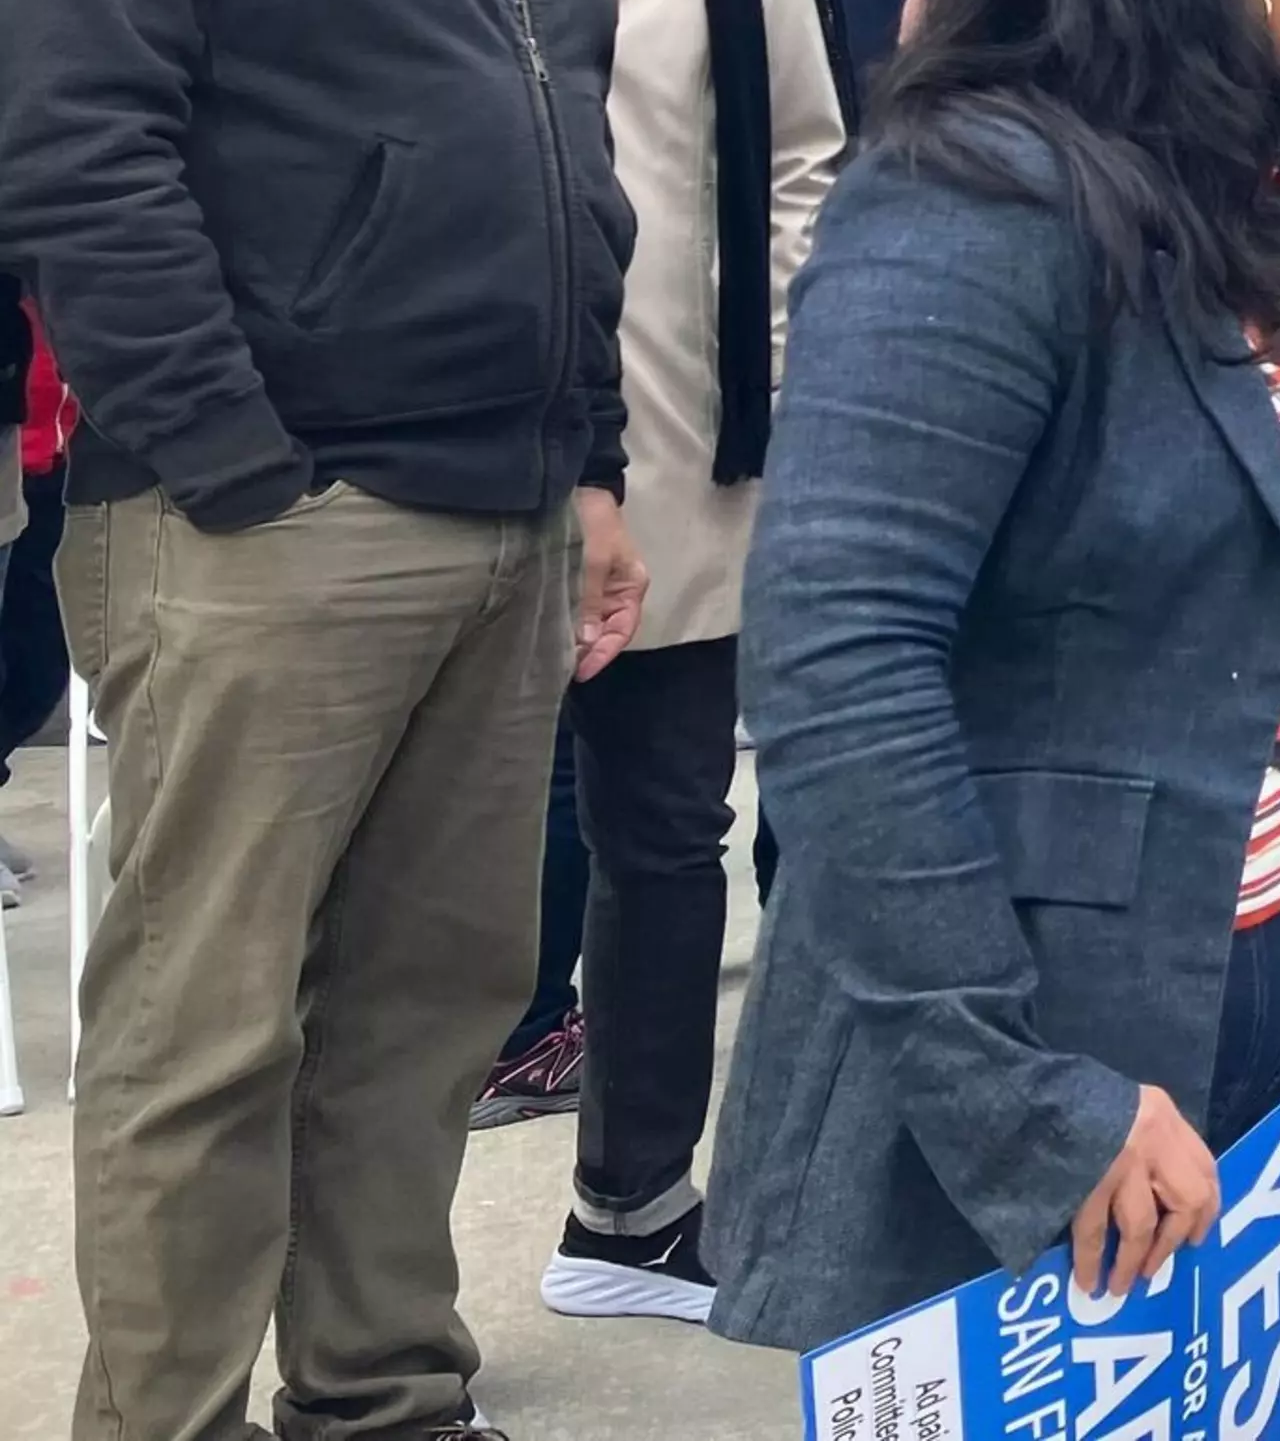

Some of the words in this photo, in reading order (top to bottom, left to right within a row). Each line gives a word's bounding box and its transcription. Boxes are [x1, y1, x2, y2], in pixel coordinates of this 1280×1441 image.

[998, 1273, 1065, 1404] SAN
[1183, 1332, 1209, 1421] FOR
[915, 1378, 948, 1412] Ad
